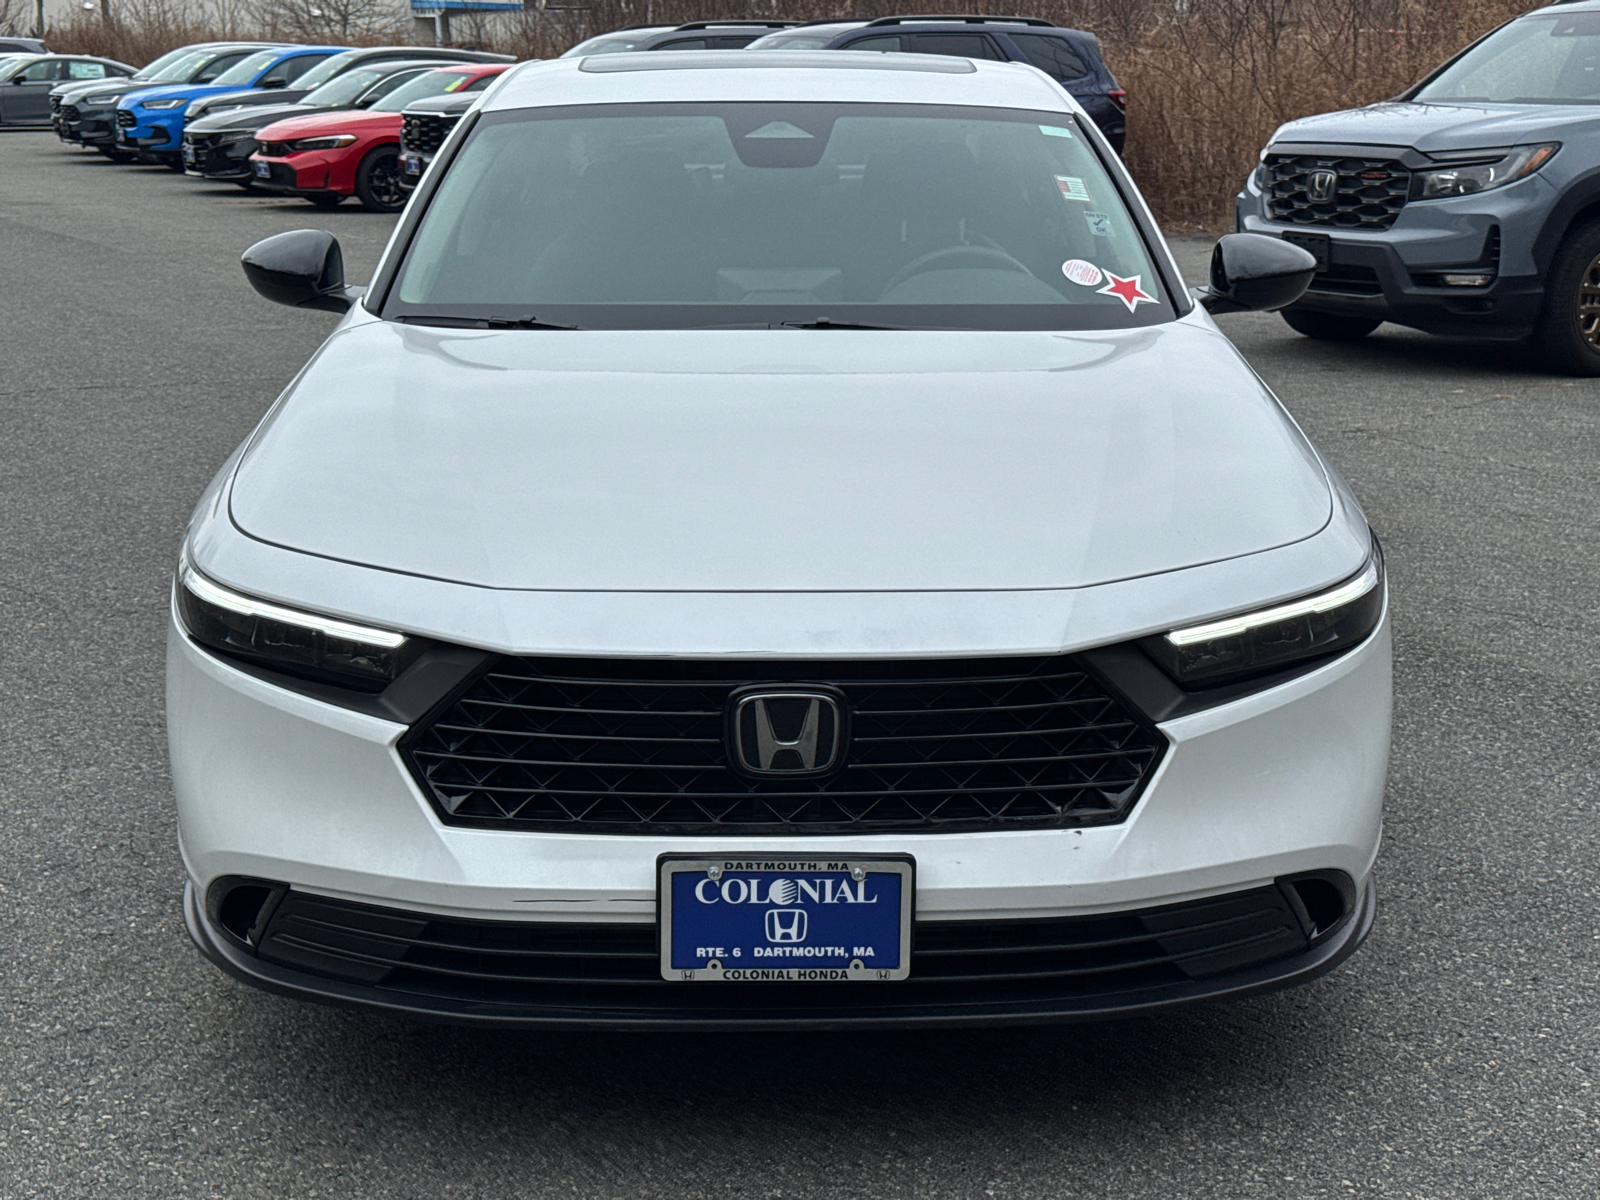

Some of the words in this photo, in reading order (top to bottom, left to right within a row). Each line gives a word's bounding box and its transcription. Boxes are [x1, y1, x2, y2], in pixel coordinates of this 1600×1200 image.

[724, 861, 822, 871] DARTMOUTH,
[827, 862, 849, 871] MA
[694, 878, 878, 906] COLONIAL
[696, 947, 729, 958] RTE.
[732, 947, 742, 958] 6
[753, 946, 849, 958] DARTMOUTH,
[852, 947, 875, 957] MA
[722, 969, 793, 981] COLONIAL
[797, 969, 849, 980] HONDA
